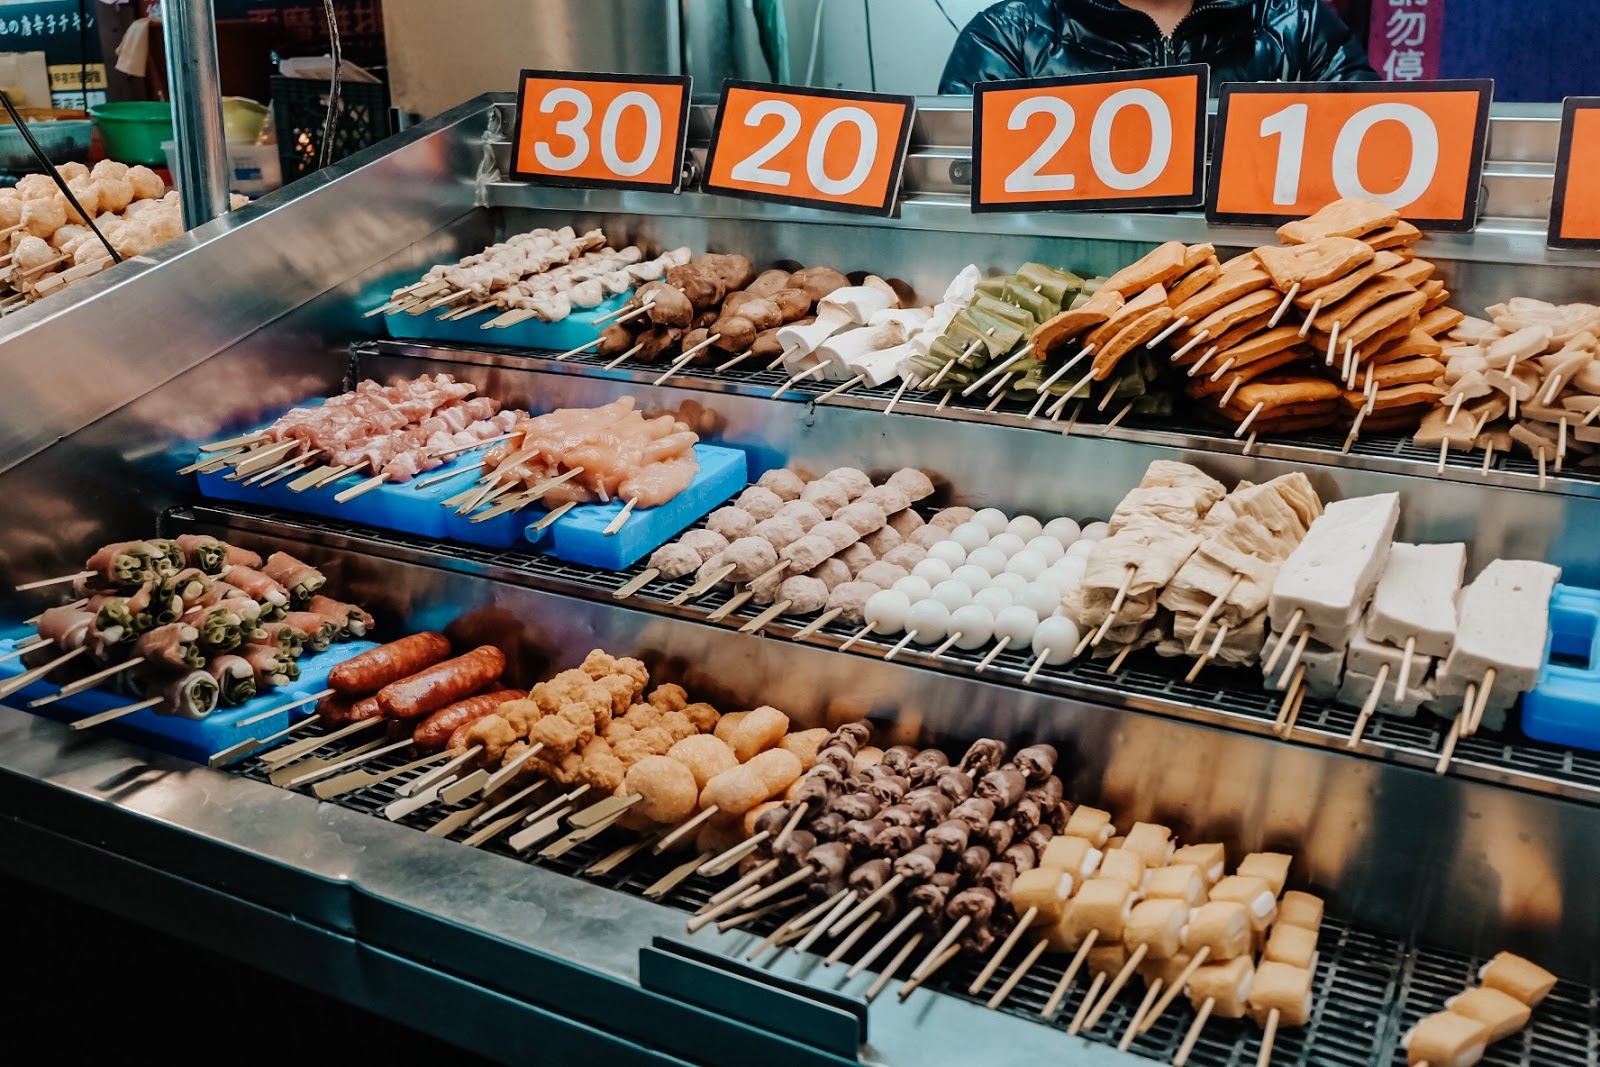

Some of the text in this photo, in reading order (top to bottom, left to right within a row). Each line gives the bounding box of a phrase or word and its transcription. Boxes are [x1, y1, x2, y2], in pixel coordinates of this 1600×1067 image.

[1383, 0, 1428, 81] 勿停
[534, 87, 662, 176] 30
[730, 99, 879, 195] 20
[1004, 88, 1173, 193] 20
[1259, 102, 1439, 210] 10
